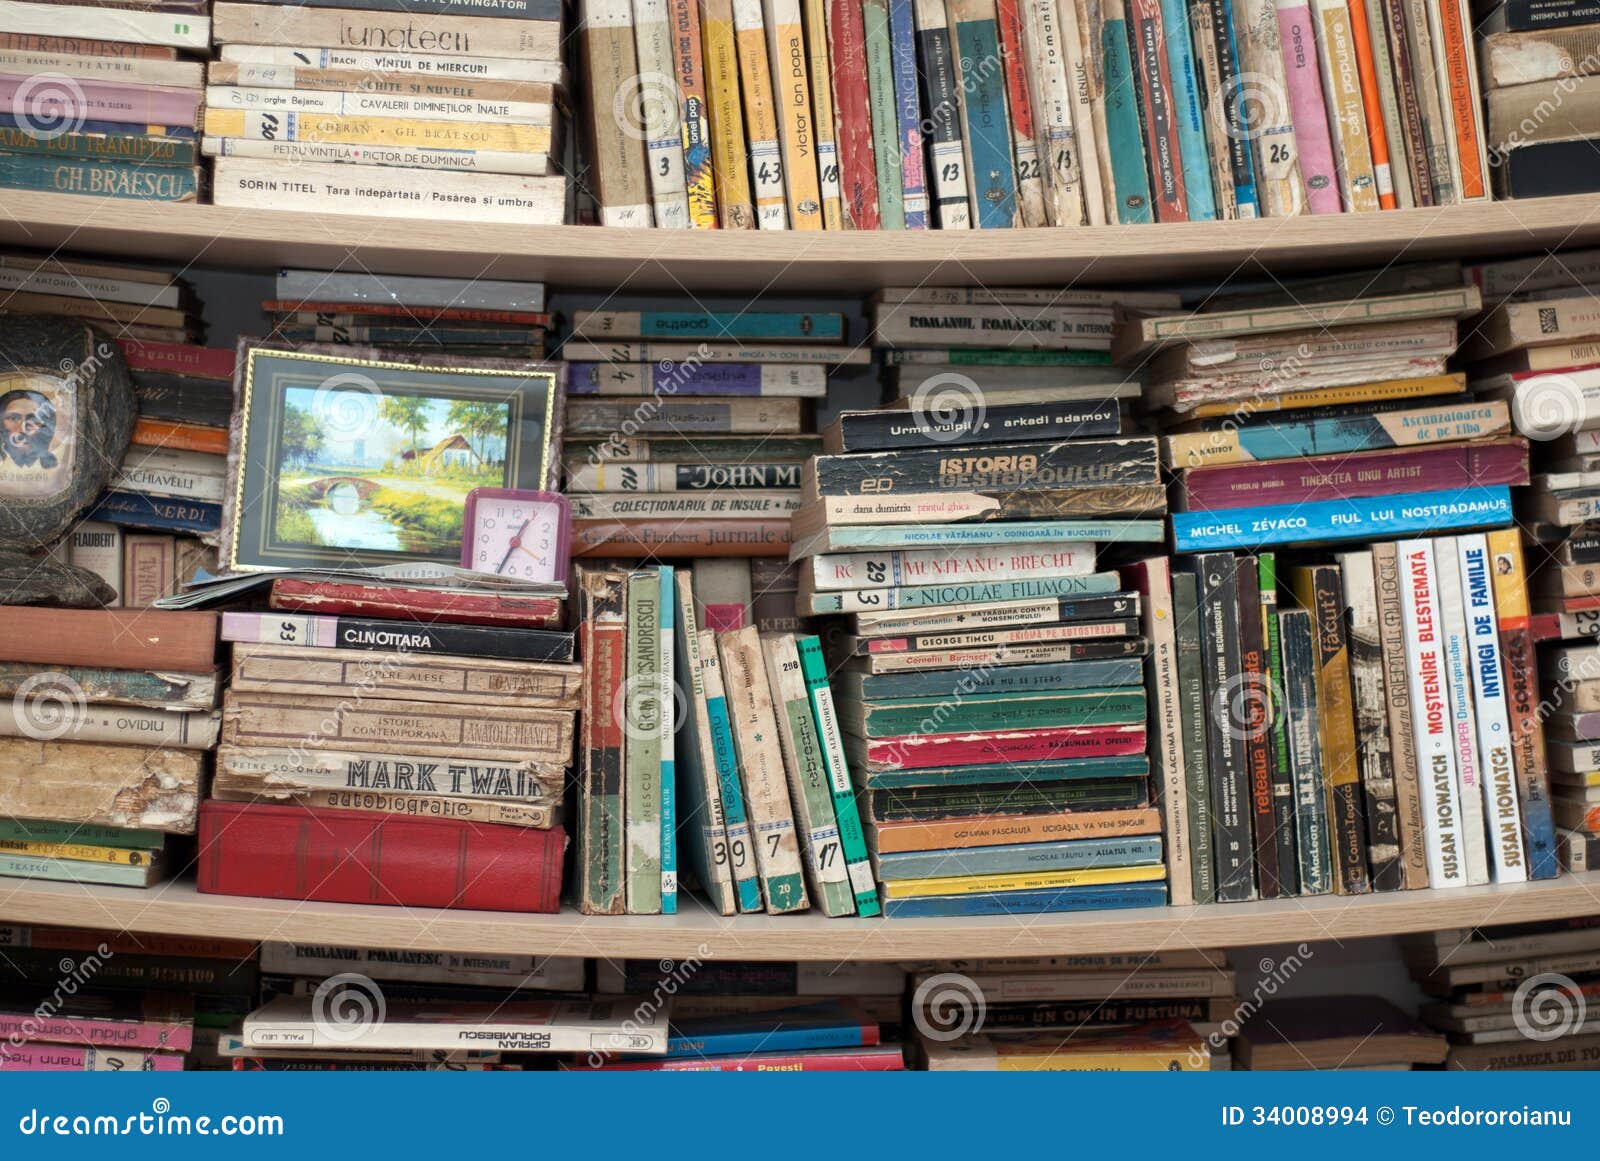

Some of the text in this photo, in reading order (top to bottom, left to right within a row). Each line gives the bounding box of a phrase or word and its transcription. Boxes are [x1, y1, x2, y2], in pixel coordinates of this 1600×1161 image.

[1146, 25, 1154, 53] ROMA
[1291, 24, 1307, 69] tasso
[418, 60, 431, 71] DE
[436, 61, 488, 75] MIERCURI
[1149, 55, 1156, 67] LA
[1333, 23, 1356, 94] populare
[1074, 61, 1089, 105] BENIUC
[1151, 69, 1159, 88] DAC
[360, 99, 410, 112] CAVALERII
[789, 37, 809, 158] victor ion popa
[1154, 91, 1162, 104] UN
[689, 98, 700, 144] ionel pop
[273, 144, 419, 164] PETRU PICTOR DE
[1056, 150, 1073, 170] 13
[1270, 143, 1290, 164] 26
[659, 156, 670, 177] 3
[758, 161, 782, 185] 43
[943, 163, 960, 182] 13
[1018, 159, 1041, 182] 22
[1163, 169, 1174, 194] TUDOR
[239, 179, 534, 209] SORIN TITEL umbra
[890, 424, 931, 436] Urma
[1003, 415, 1050, 428] arkadi
[1055, 411, 1112, 425] adamov
[1454, 422, 1482, 438] Elba
[939, 454, 1038, 476] ISTORIA
[1357, 465, 1422, 483] UNUI ARTIST
[690, 464, 767, 489] JOHN
[711, 500, 770, 513] DE INSULE
[853, 503, 874, 515] dana
[875, 502, 912, 515] dumitriu
[1190, 497, 1508, 539] MICHEL ZÉVACO FIUL LUI NOSTRADAMUS
[73, 533, 116, 549] FLAUBERT
[705, 525, 776, 547] Jurnale
[1011, 551, 1076, 571] BRECHT
[866, 560, 888, 585] 29
[857, 590, 880, 607] 3
[920, 577, 1089, 606] NICOLAE FILIMON
[279, 621, 297, 643] 53
[1213, 600, 1224, 653] NECUNOSCUTE
[922, 635, 963, 647] GEORGE
[965, 633, 995, 645] TIMCU
[1161, 643, 1168, 654] SA
[408, 671, 445, 684] ALESE
[1453, 661, 1466, 683] spre
[1165, 689, 1174, 729] PENTRU
[1465, 548, 1521, 868] SUSAN HOWATCH INTRIGI DE FAMILIE
[116, 717, 165, 733] OVIDIU
[821, 690, 845, 789] GRIGORE ALEXANDRESCU
[1457, 721, 1473, 763] COOPER
[346, 758, 441, 793] MARK
[1195, 750, 1206, 792] castelul
[1463, 766, 1476, 787] JILLY
[328, 789, 474, 818] autobiografie
[1097, 820, 1116, 830] VENI
[1117, 818, 1146, 829] SINGUR
[1431, 754, 1459, 880] SUSAN HOWATCH
[714, 841, 727, 866] 3
[732, 839, 746, 868] 9
[767, 833, 782, 858] 7
[818, 842, 838, 871] 17
[89, 1024, 139, 1041] ghidul
[283, 1033, 305, 1042] PAUL
[459, 1031, 551, 1041] PORUMBESCU
[497, 1040, 551, 1049] CIPRIAN
[40, 1055, 86, 1068] mann
[1556, 1049, 1578, 1066] DE
